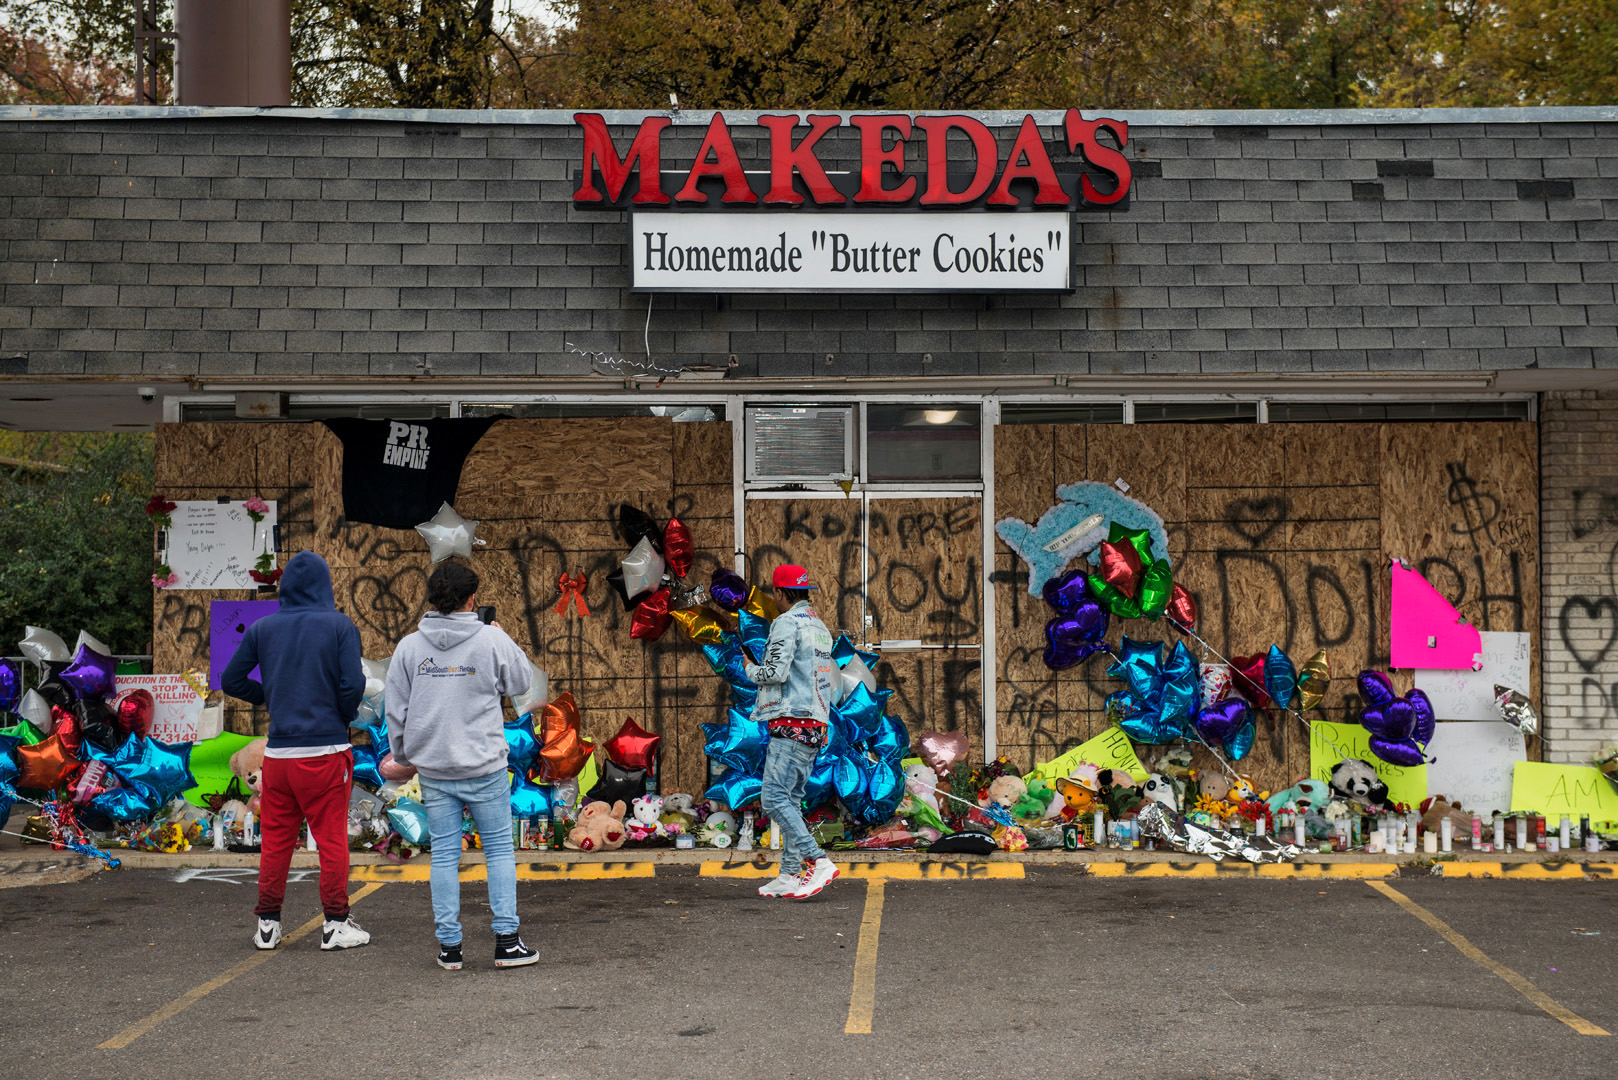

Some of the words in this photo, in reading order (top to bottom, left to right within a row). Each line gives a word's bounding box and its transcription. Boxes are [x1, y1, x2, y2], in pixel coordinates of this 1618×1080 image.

[572, 107, 1132, 207] MAKEDA'S
[643, 231, 802, 272] Homemade
[812, 230, 920, 273] "Butter
[932, 230, 1062, 273] Cookies"
[114, 676, 156, 684] DUCATION
[158, 675, 166, 684] IS
[155, 692, 197, 700] KILLING
[145, 733, 198, 743] 7-3149
[153, 723, 198, 733] F.F.U.N.
[1101, 730, 1141, 774] HONK
[82, 762, 108, 788] LOVE
[1546, 774, 1603, 809] AM
